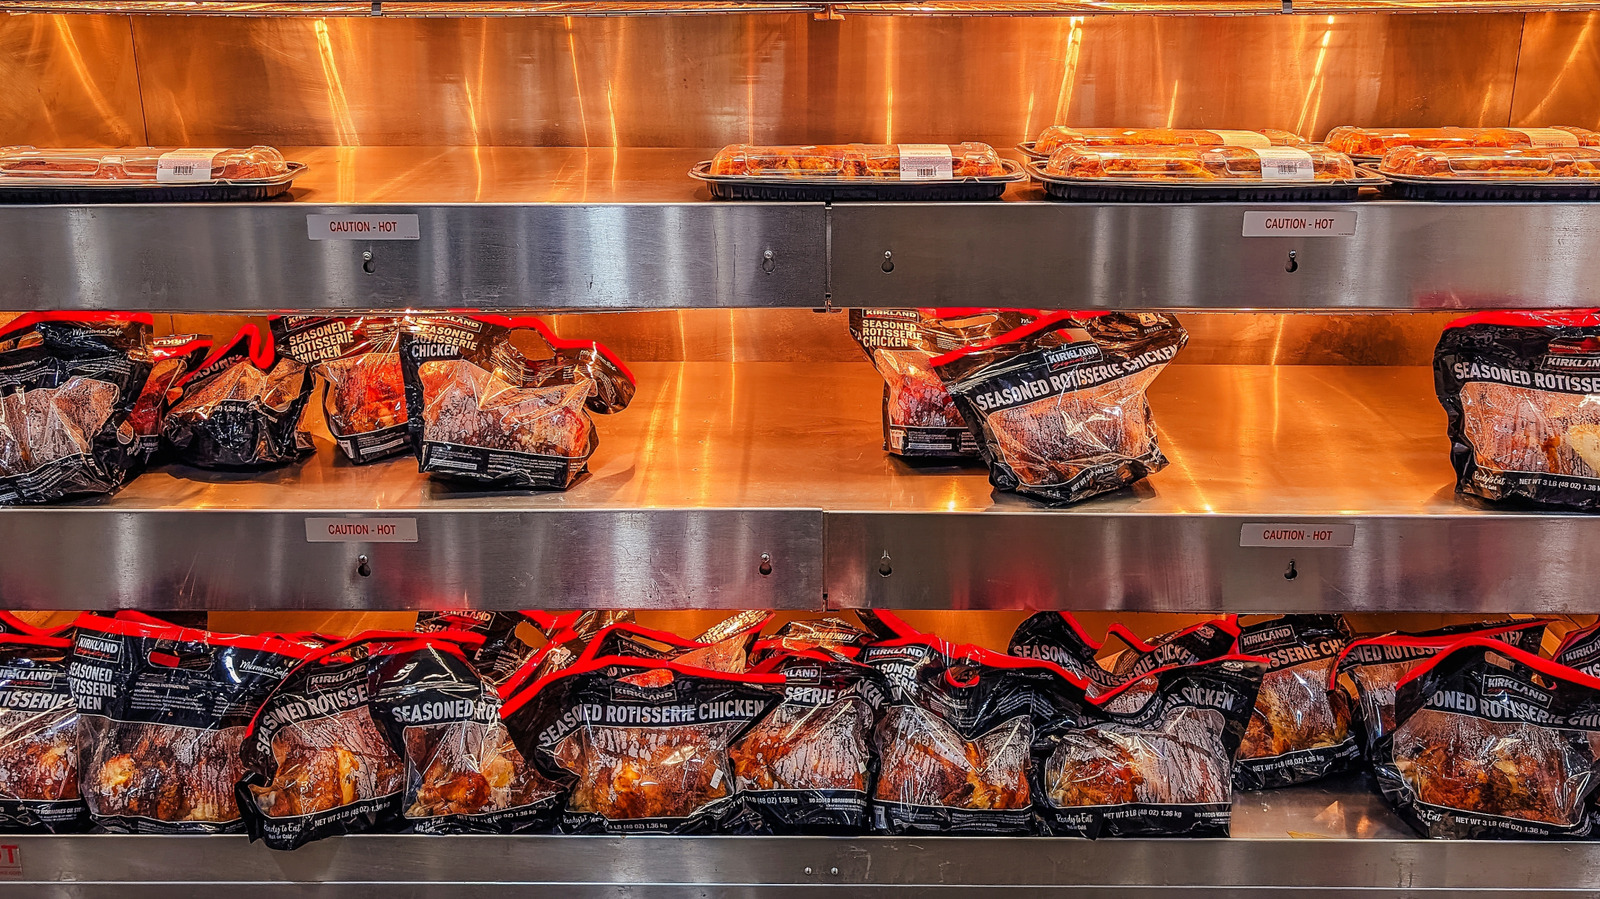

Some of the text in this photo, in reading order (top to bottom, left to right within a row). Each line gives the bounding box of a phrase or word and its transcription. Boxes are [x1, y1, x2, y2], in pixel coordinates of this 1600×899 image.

[329, 221, 370, 232] CAUTION
[378, 221, 397, 232] HOT
[1265, 218, 1306, 229] CAUTION
[1314, 218, 1334, 229] HOT
[866, 309, 917, 318] KIRKLAND
[289, 321, 346, 346] SEASONED
[420, 325, 474, 341] EASONED
[862, 320, 917, 332] SEASONED
[862, 328, 922, 340] ROTISSERIE
[291, 330, 354, 356] ROTISSERIE
[412, 334, 478, 351] ROTISSERIE
[862, 336, 908, 348] CHICKEN
[412, 344, 459, 358] CHICKEN
[1048, 346, 1099, 364] KIRKLAND
[1547, 357, 1600, 367] KIRKLAN
[976, 344, 1180, 411] SEASONED ROTISSERIE CHICKEN
[1454, 362, 1600, 393] SEASONED ROTISSE
[1558, 480, 1568, 489] (48
[1570, 482, 1581, 490] OZ)
[328, 524, 369, 535] CAUTION
[377, 524, 396, 535] HOT
[1263, 530, 1304, 540] CAUTION
[1312, 530, 1333, 540] HOT
[1243, 628, 1291, 646] KIRKLAND
[78, 637, 118, 654] KIRKLAND
[869, 648, 924, 658] KIRKLAND
[1565, 641, 1600, 662] KIRKLA
[0, 669, 52, 680] IRKLAND
[70, 662, 113, 683] SEASONED
[311, 664, 366, 685] KIRKLAND
[614, 688, 674, 700] KIRKLAND
[786, 686, 836, 704] SSERIE
[1488, 678, 1548, 702] KIRKLAND
[0, 690, 68, 710] TISSERIE
[308, 683, 369, 716] ROTISSE
[392, 700, 474, 722] SEASONED
[606, 703, 696, 722] ROTISSERIE
[698, 700, 765, 720] CHICKEN
[1480, 698, 1564, 724] ROTISSERIE
[791, 796, 798, 804] kg
[1174, 810, 1182, 818] kg
[314, 818, 326, 827] NET
[1456, 816, 1468, 824] NET
[1510, 824, 1522, 832] OZ)
[0, 844, 18, 864] T
